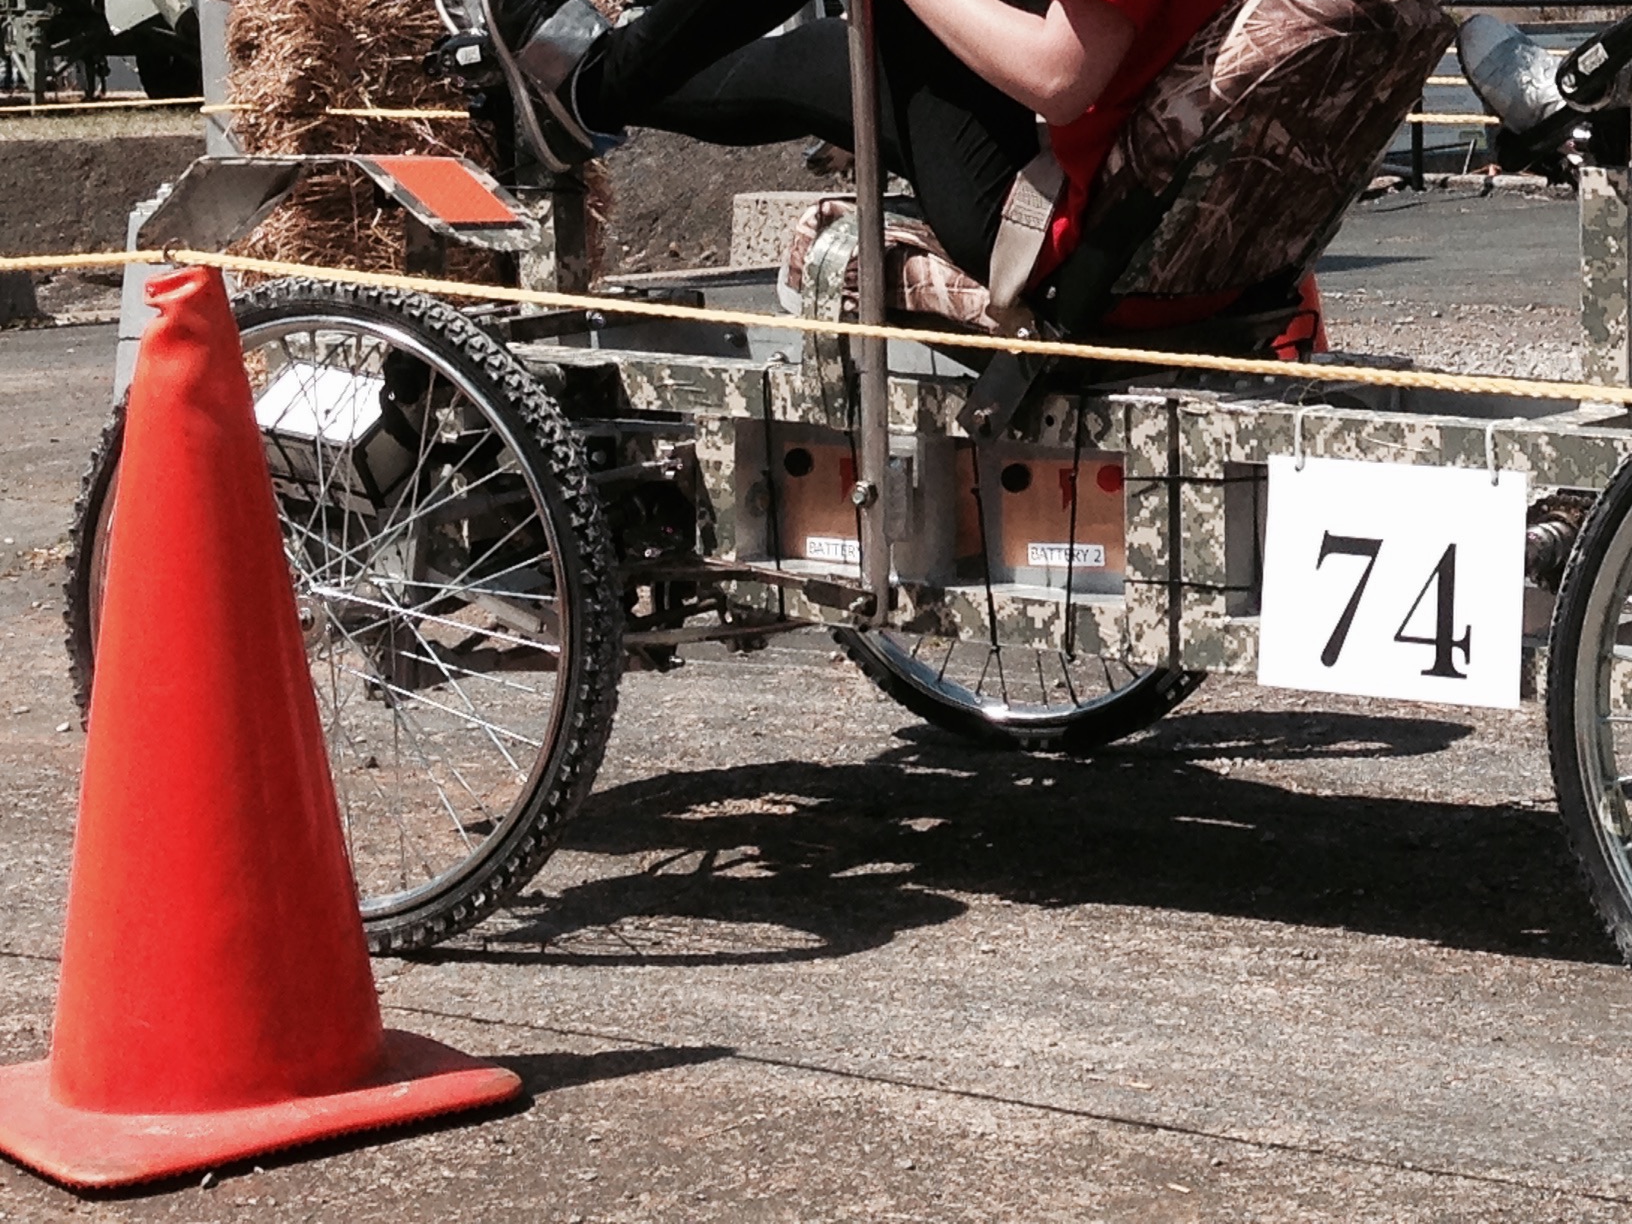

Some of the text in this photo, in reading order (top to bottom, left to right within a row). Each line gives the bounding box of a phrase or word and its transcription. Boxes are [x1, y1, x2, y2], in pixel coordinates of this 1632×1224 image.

[1030, 546, 1103, 563] BATTERY 2
[1315, 529, 1472, 680] 74
